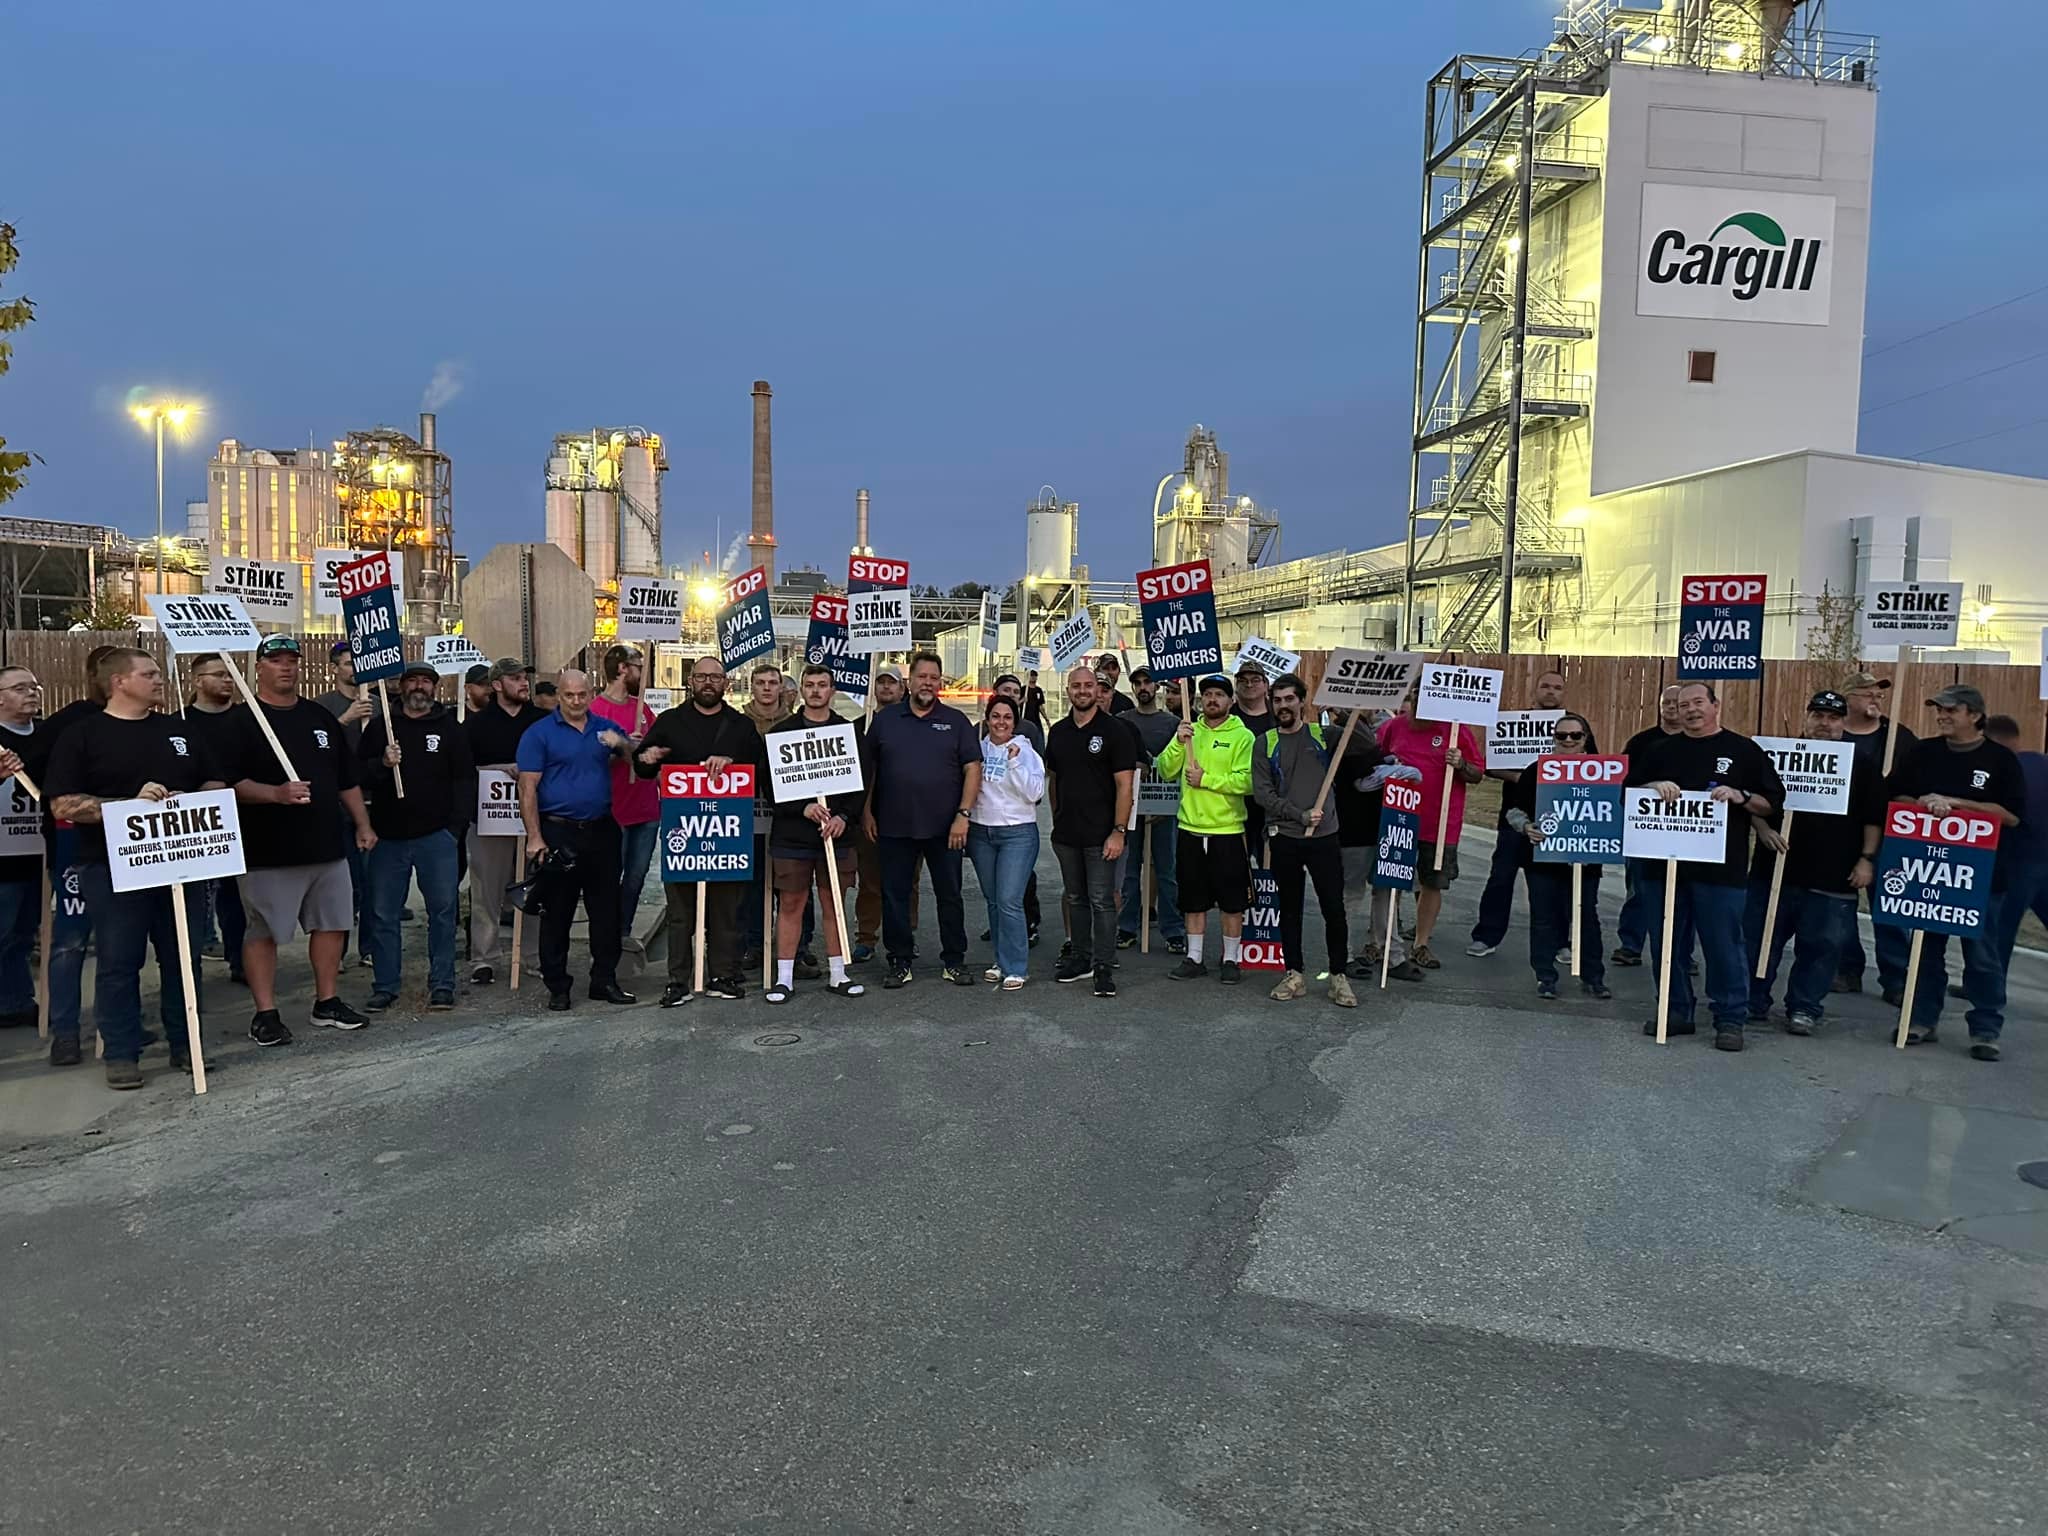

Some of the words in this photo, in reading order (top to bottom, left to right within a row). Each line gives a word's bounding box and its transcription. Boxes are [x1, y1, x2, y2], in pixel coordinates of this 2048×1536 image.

[1647, 230, 1821, 300] Cargill
[225, 566, 285, 590] STRIKE
[341, 560, 386, 595] STOP
[852, 560, 906, 582] STOP
[1142, 568, 1206, 600] STOP
[1686, 581, 1762, 601] STOP
[247, 597, 270, 605] UNION
[361, 596, 373, 607] THE
[630, 588, 678, 608] STRIKE
[1169, 601, 1184, 612] THE
[1877, 592, 1949, 612] STRIKE
[166, 603, 236, 620] STRIKE
[625, 616, 644, 624] LOCAL
[726, 605, 762, 634] WAR
[816, 601, 848, 621] ST
[855, 601, 902, 620] STRIKE
[1714, 608, 1730, 617] THE
[354, 607, 390, 636] WAR
[1156, 611, 1206, 638] WAR
[1696, 620, 1750, 640] WAR
[892, 628, 904, 636] 238
[1054, 617, 1086, 650] STRIKE
[369, 638, 378, 648] ON
[437, 640, 476, 652] STRI
[724, 630, 771, 663] WORKERS
[1176, 639, 1188, 650] ON
[1713, 643, 1727, 652] ON
[353, 646, 400, 672] WORKERS
[834, 658, 845, 668] ON
[1152, 648, 1218, 671] WORKERS
[1248, 645, 1290, 670] STRIKE
[1682, 656, 1756, 670] WORKERS
[831, 669, 868, 686] KERS
[1338, 659, 1410, 680] STRIKE
[1328, 685, 1354, 694] LOCAL
[1432, 672, 1492, 690] STRIKE
[1496, 721, 1554, 738] STRIKE
[780, 736, 846, 764] STRIKE
[782, 774, 807, 784] LOCAL
[808, 771, 834, 780] UNION
[835, 767, 851, 776] 238
[1542, 760, 1623, 781] STOP
[668, 772, 750, 794] STOP
[1786, 775, 1816, 784] TEAMSTERS
[1823, 777, 1846, 786] HELPERS
[1787, 784, 1816, 793] UNION
[1818, 786, 1838, 795] 238
[1386, 784, 1421, 810] STOP
[1572, 788, 1590, 797] THE
[166, 800, 180, 810] ON
[699, 802, 717, 812] THE
[1553, 800, 1612, 822] WAR
[1638, 798, 1714, 818] STRIKE
[9, 827, 38, 835] LOCAL
[127, 806, 224, 841] STRIKE
[680, 816, 740, 838] WAR
[1572, 825, 1586, 834] ON
[1666, 824, 1696, 832] UNION
[1892, 810, 1994, 843] STOP
[164, 836, 202, 850] TEAMSTERS
[209, 832, 237, 844] HELPERS
[701, 841, 715, 851] ON
[1388, 825, 1413, 850] WAR
[1540, 837, 1620, 853] WORKERS
[129, 853, 166, 867] LOCAL
[168, 848, 204, 861] UNION
[207, 844, 230, 856] 238
[1927, 845, 1949, 858] THE
[667, 854, 749, 871] WORKERS
[1378, 860, 1413, 880] WORKERS
[1902, 857, 1974, 890] WAR
[1922, 888, 1940, 900] ON
[1880, 896, 1980, 926] WORKERS
[1256, 929, 1270, 938] THE
[1240, 944, 1285, 964] TO
